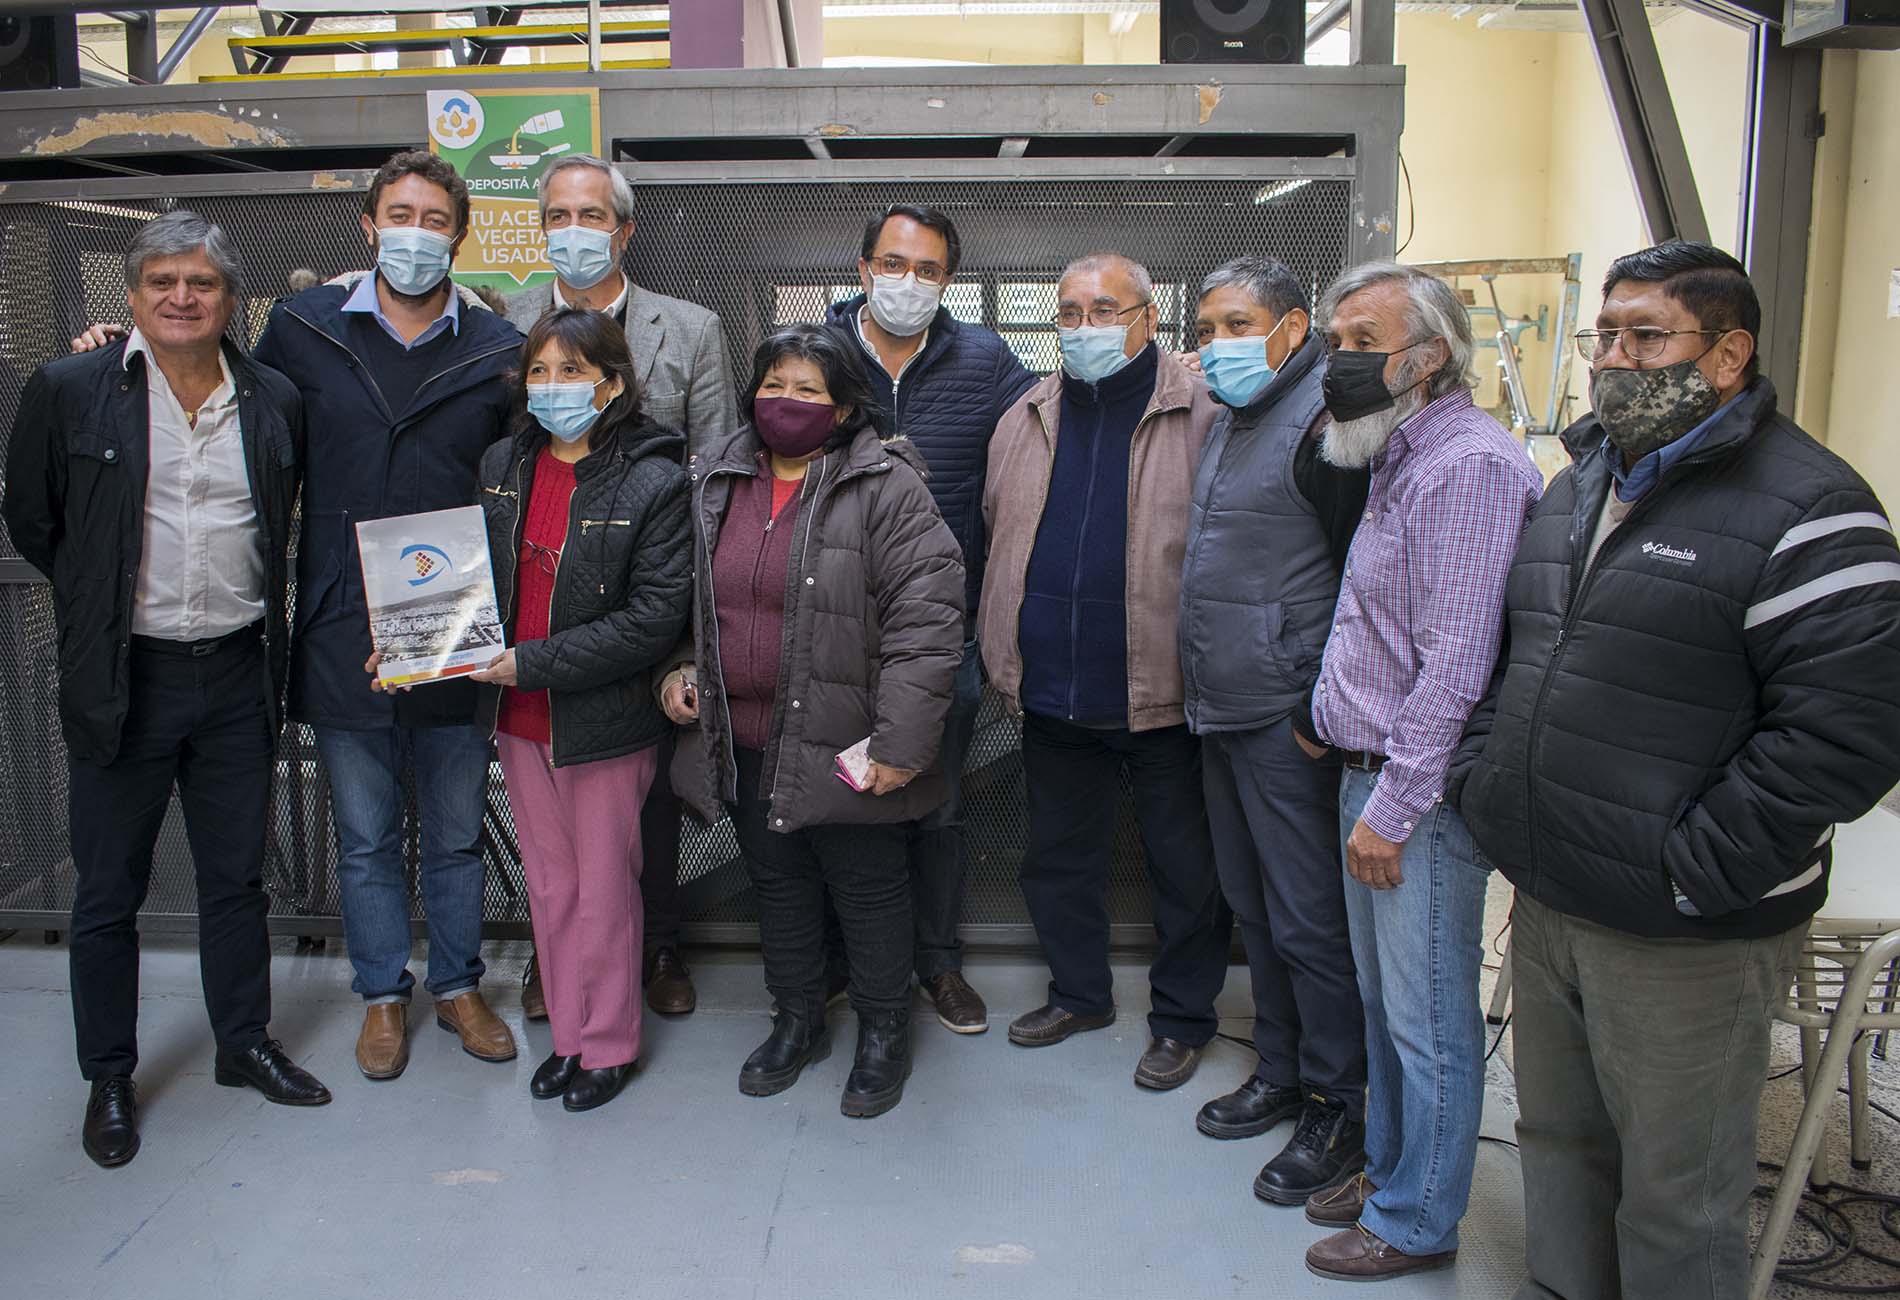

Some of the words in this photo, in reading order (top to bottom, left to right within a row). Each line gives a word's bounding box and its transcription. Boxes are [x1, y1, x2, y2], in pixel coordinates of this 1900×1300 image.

[465, 176, 530, 190] DEPOSITÁ
[470, 209, 494, 227] TU
[498, 209, 542, 227] ACE
[1652, 543, 1697, 561] Columbia
